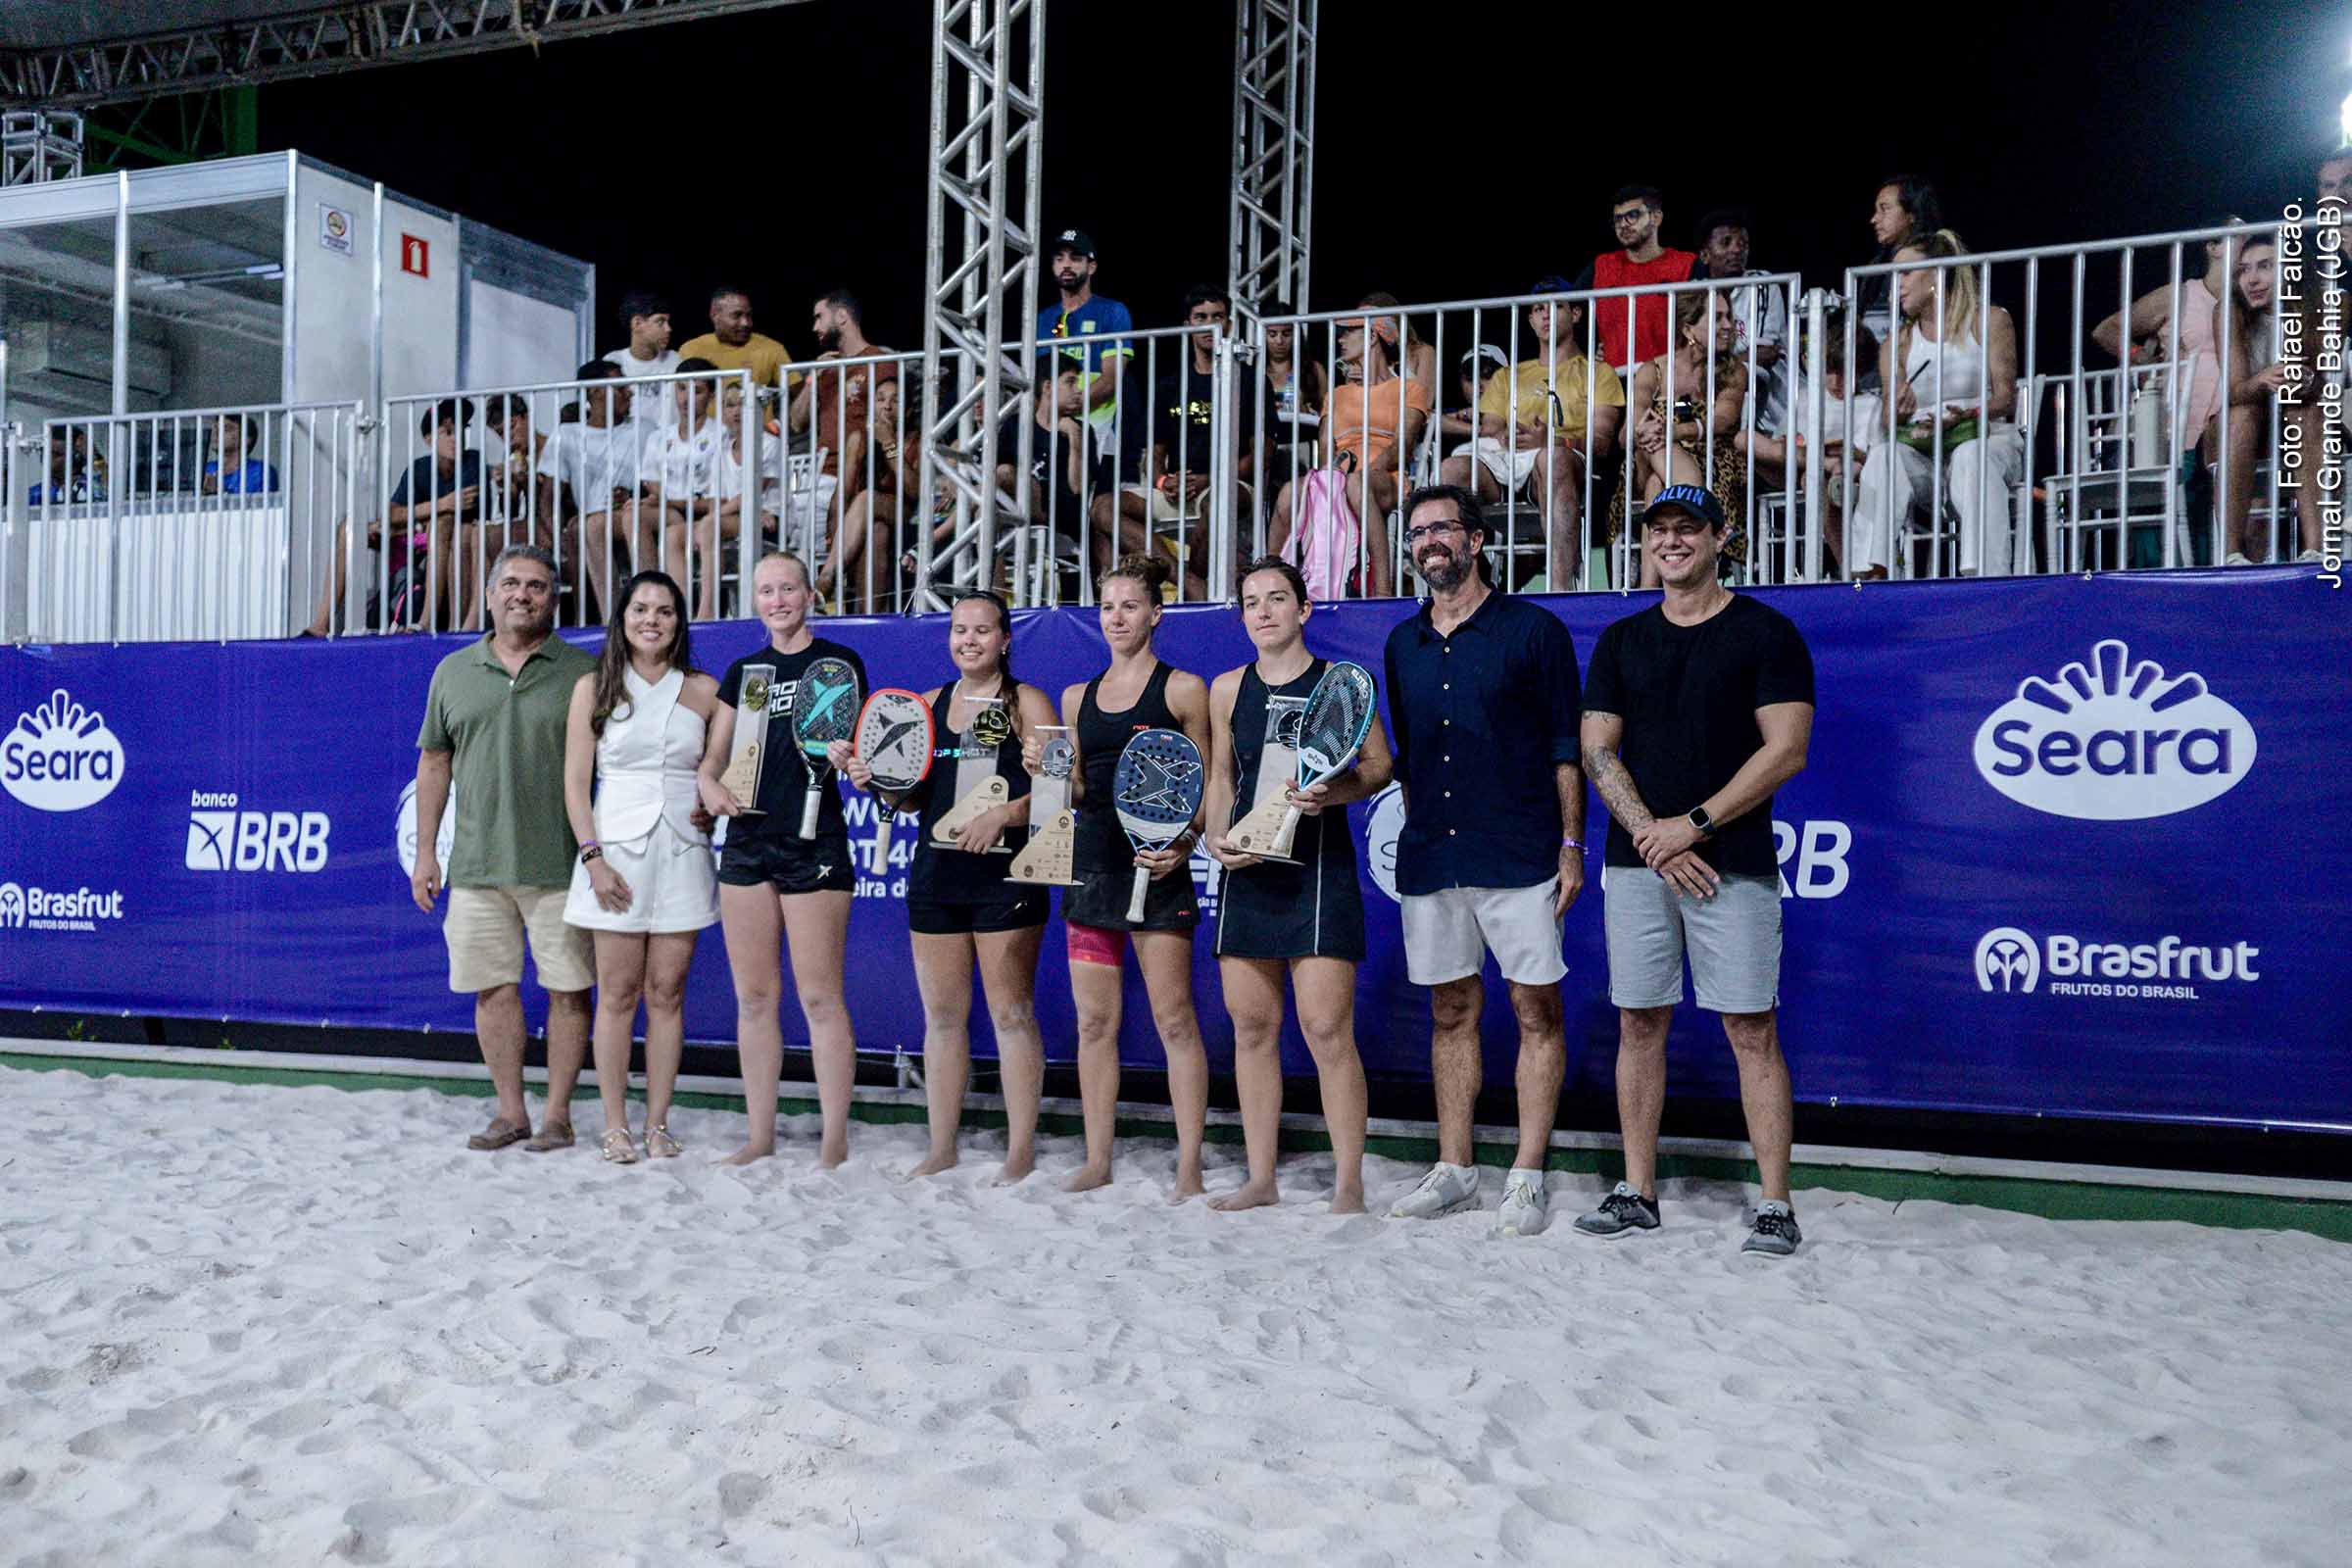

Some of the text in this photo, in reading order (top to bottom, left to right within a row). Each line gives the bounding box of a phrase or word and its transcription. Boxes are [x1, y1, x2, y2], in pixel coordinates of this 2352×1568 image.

[1654, 485, 1706, 507] ALVIN
[5, 742, 114, 782] Seara
[1991, 719, 2233, 777] Seara
[191, 789, 238, 808] banco
[235, 810, 331, 873] BRB
[1771, 820, 1852, 899] RB
[27, 886, 123, 919] Brasfrut
[2047, 934, 2260, 982] Brasfrut
[2051, 982, 2199, 1000] FRUTOS DO BRASIL
